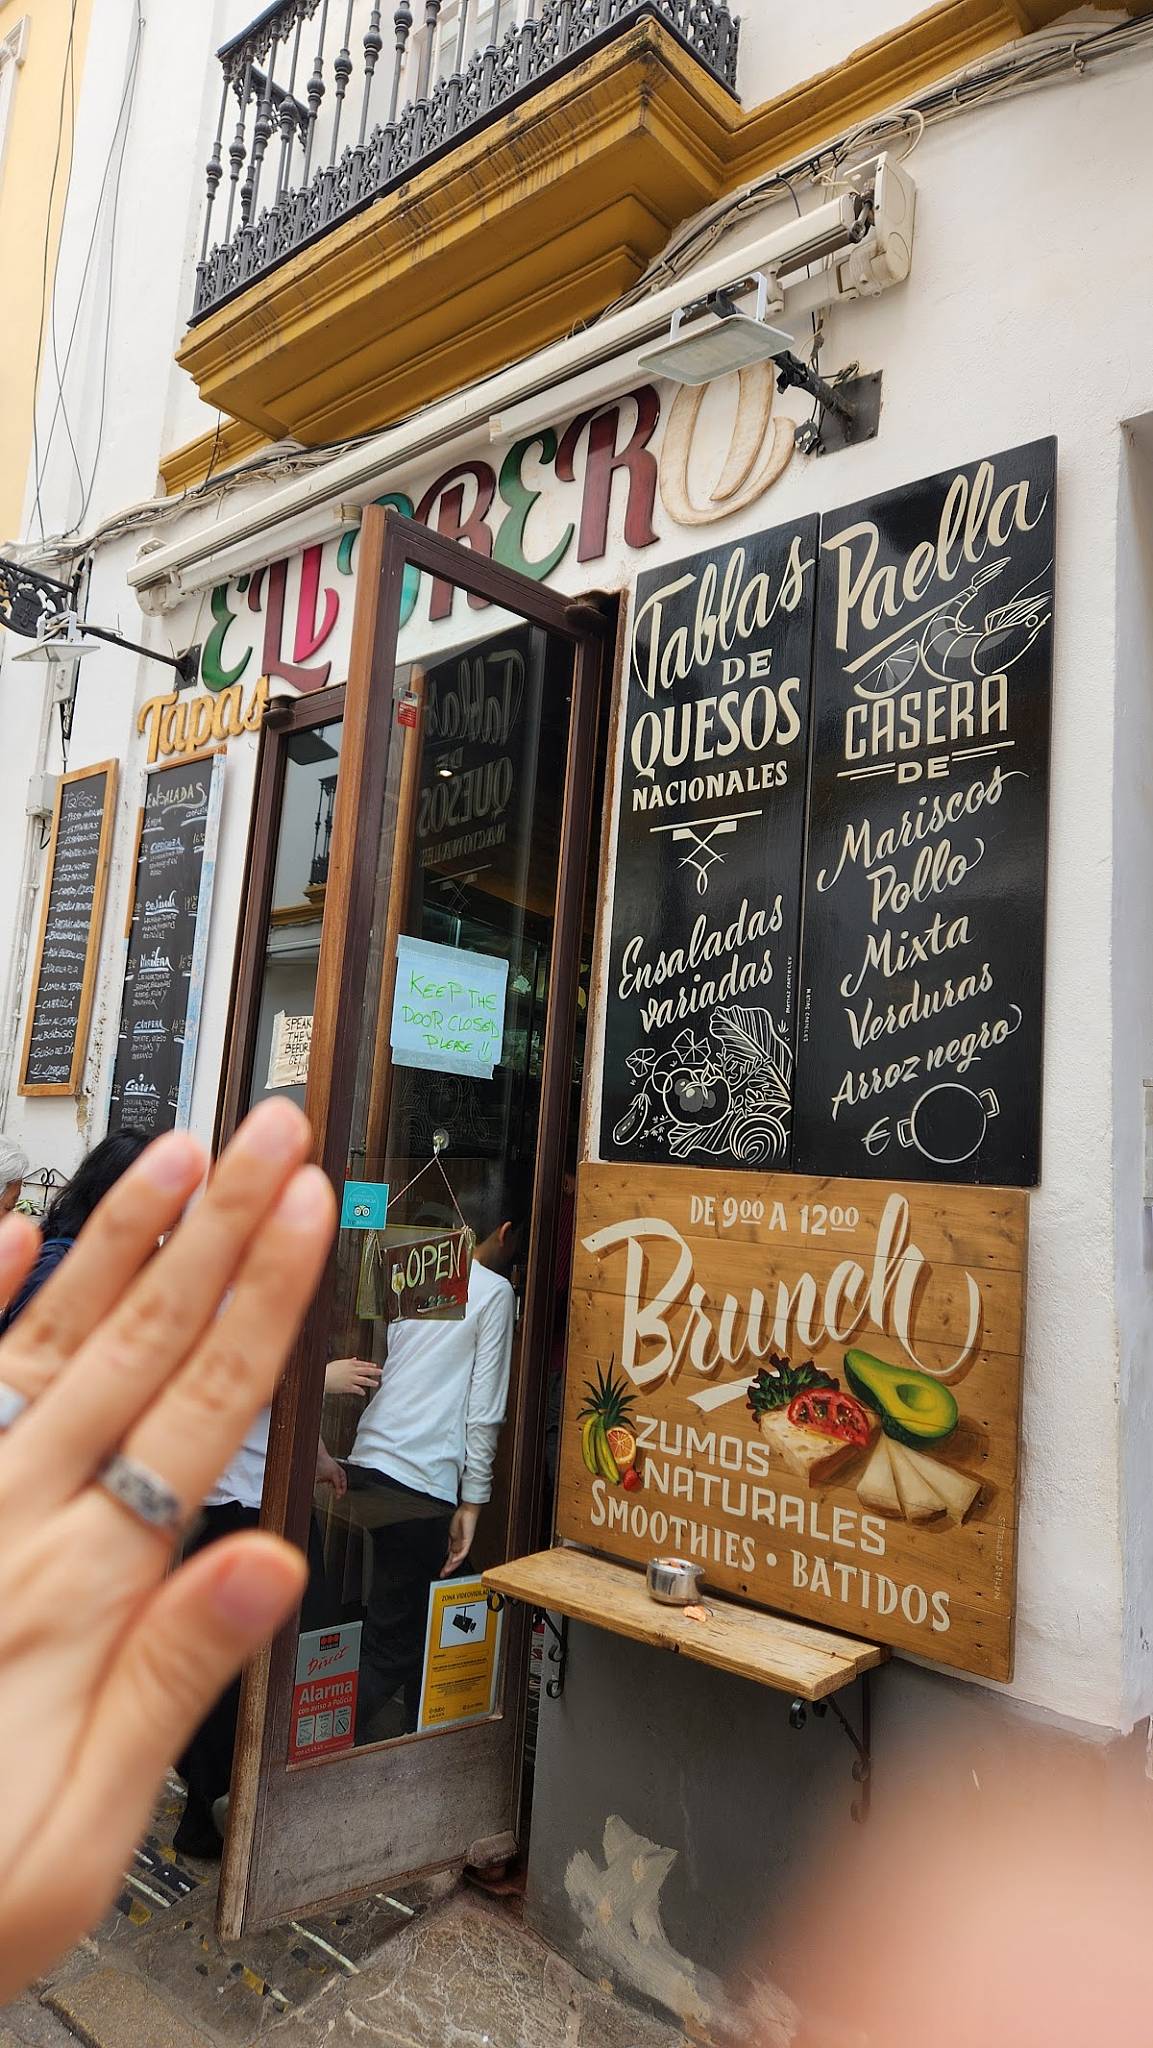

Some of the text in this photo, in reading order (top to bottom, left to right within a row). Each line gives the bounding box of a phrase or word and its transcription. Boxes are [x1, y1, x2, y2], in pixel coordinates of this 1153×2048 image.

[821, 460, 1049, 652] Paella
[632, 536, 815, 699] Tablas
[721, 649, 772, 686] DE
[137, 675, 269, 764] Tapas
[630, 677, 801, 781] QUESOS
[845, 673, 1008, 760] CASERA
[632, 760, 788, 812] NACIONALES
[898, 756, 950, 784] DE
[816, 765, 1029, 892] Mariscos
[866, 837, 984, 925] Pollo
[618, 894, 783, 999] Ensaladas
[840, 912, 974, 997] Mixta
[285, 1017, 312, 1032] SPEAK
[402, 1005, 499, 1039] DOOR CLOSED
[410, 970, 497, 1010] KEEP THE
[640, 949, 773, 1033] variadas
[844, 962, 993, 1050] Verduras
[288, 1031, 304, 1043] THE
[288, 1053, 304, 1065] GET
[423, 1034, 473, 1053] PLEASE
[832, 1003, 1022, 1122] Arroz negro
[690, 1196, 715, 1226] DE
[769, 1202, 788, 1232] A
[406, 1233, 465, 1288] OPEN
[581, 1193, 981, 1386] Brunch
[636, 1415, 770, 1477] ZUMOS
[644, 1457, 886, 1556] NATURALES
[590, 1479, 950, 1633] SMOOTHIES BATIDOS
[299, 1681, 352, 1705] Alarma
[311, 1702, 327, 1711] aviso
